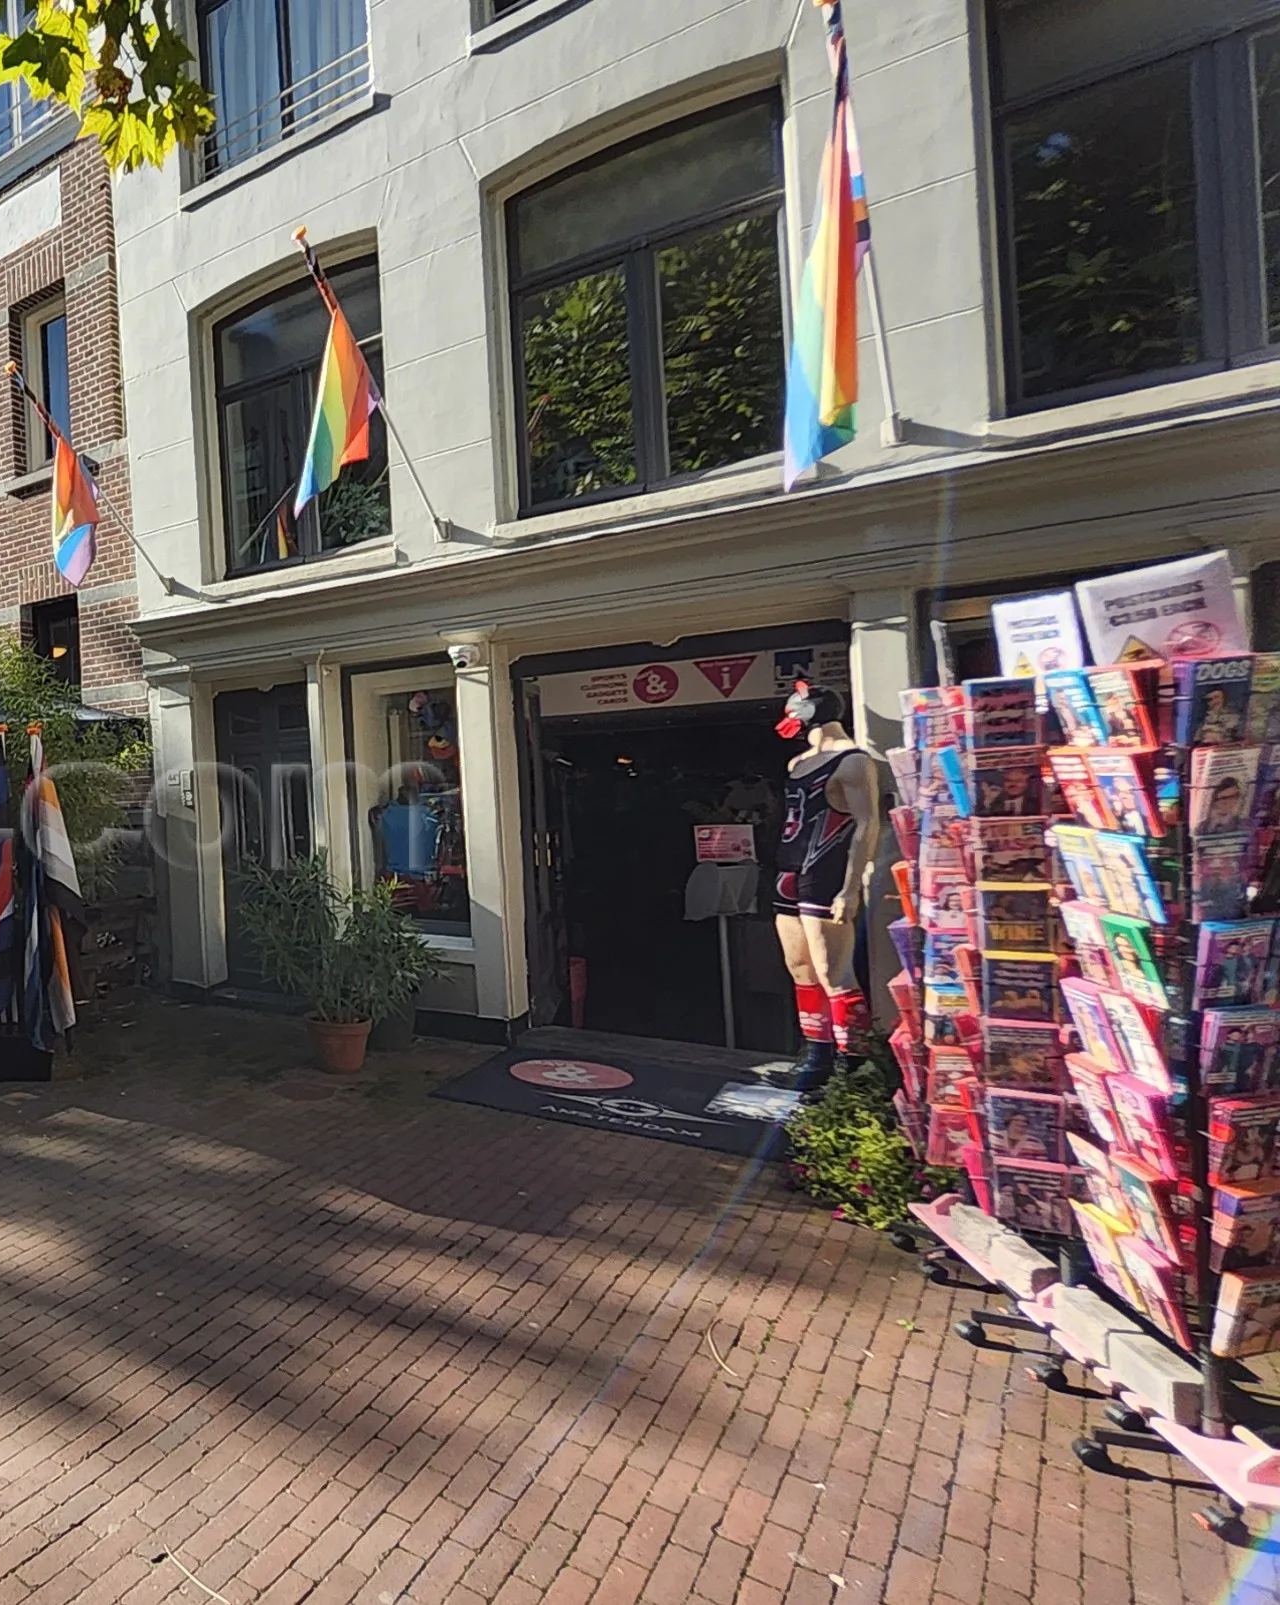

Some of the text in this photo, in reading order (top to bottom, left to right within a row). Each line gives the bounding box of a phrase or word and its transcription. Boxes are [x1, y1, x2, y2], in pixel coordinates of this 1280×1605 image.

[1195, 660, 1251, 681] DOGS
[590, 673, 628, 682] SPORTS
[580, 682, 628, 691] CLOTHING
[586, 689, 628, 698] GADGETS
[597, 697, 629, 705] CARDS
[539, 1104, 703, 1138] AMSTERDAM
